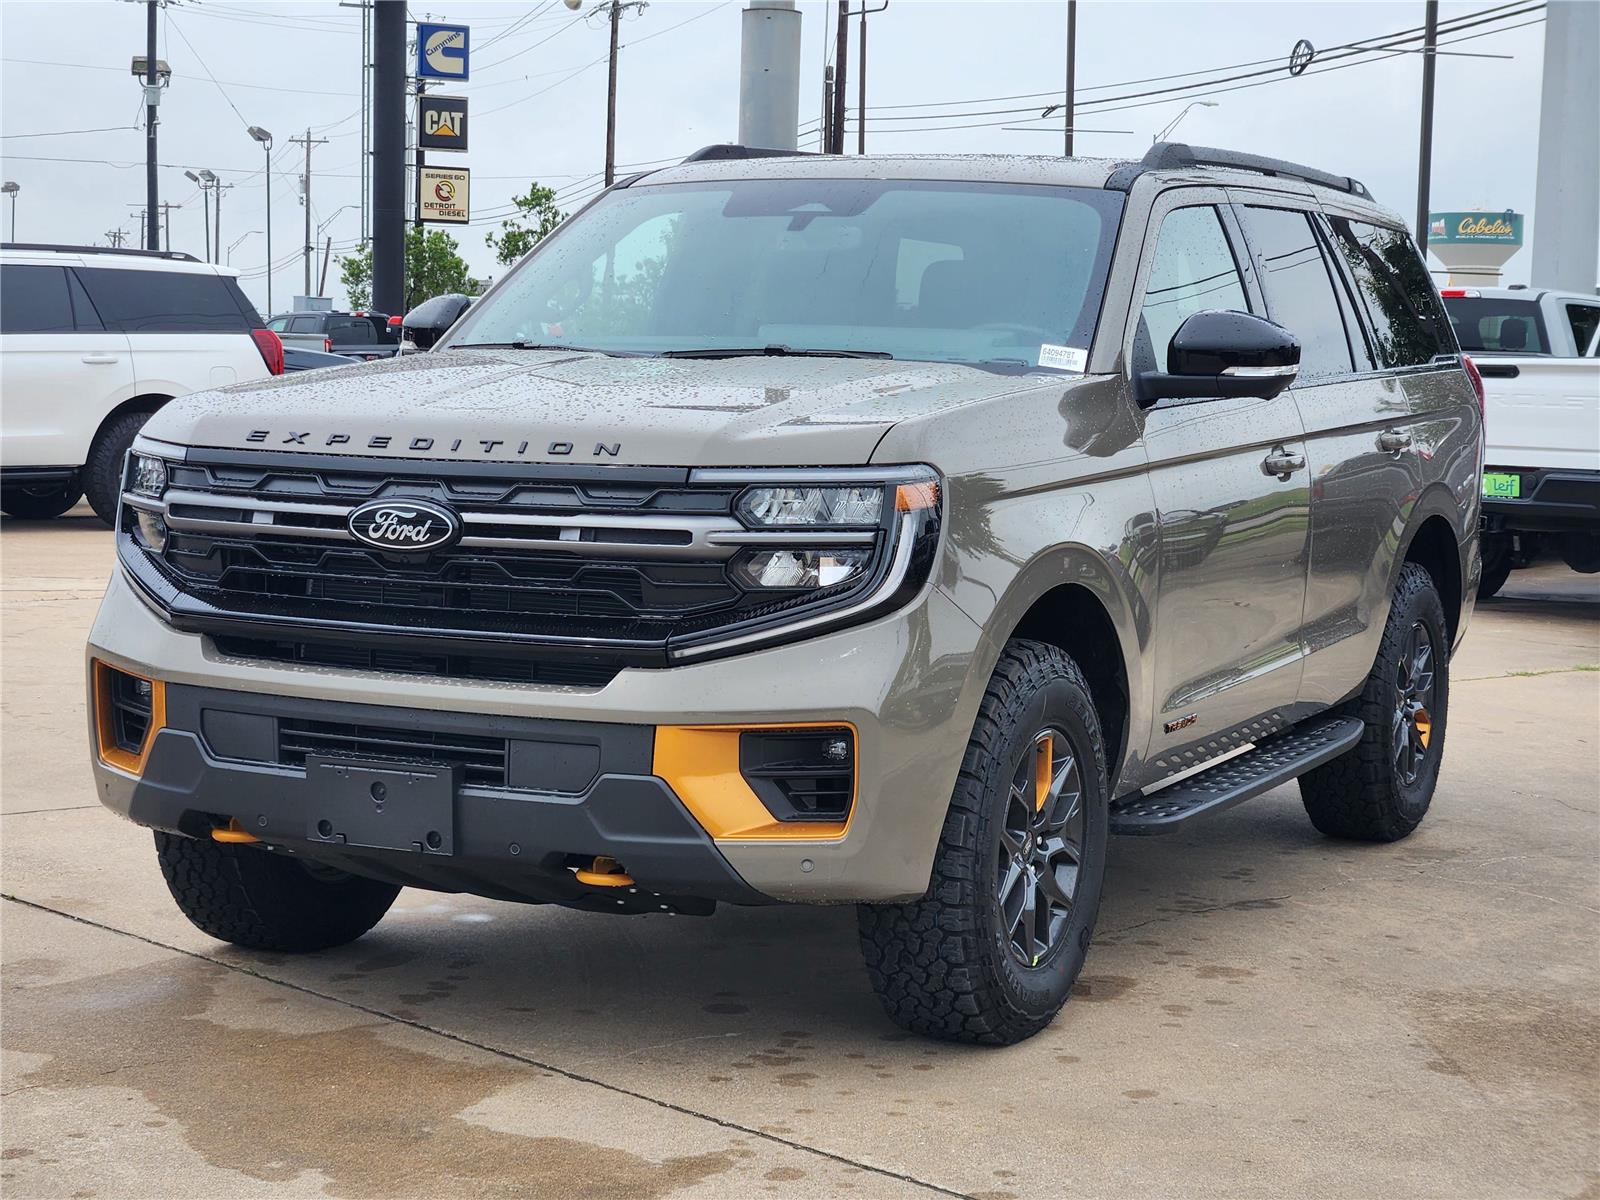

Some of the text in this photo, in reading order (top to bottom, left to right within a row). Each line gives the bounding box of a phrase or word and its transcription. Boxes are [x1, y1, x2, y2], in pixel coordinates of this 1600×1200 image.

[426, 32, 461, 56] Cummins
[425, 110, 464, 137] CAT
[425, 172, 454, 181] SERIES
[438, 210, 466, 218] DIESEL
[1458, 217, 1513, 235] Cabela's
[246, 429, 621, 456] EXPEDITION
[368, 509, 432, 542] Ford
